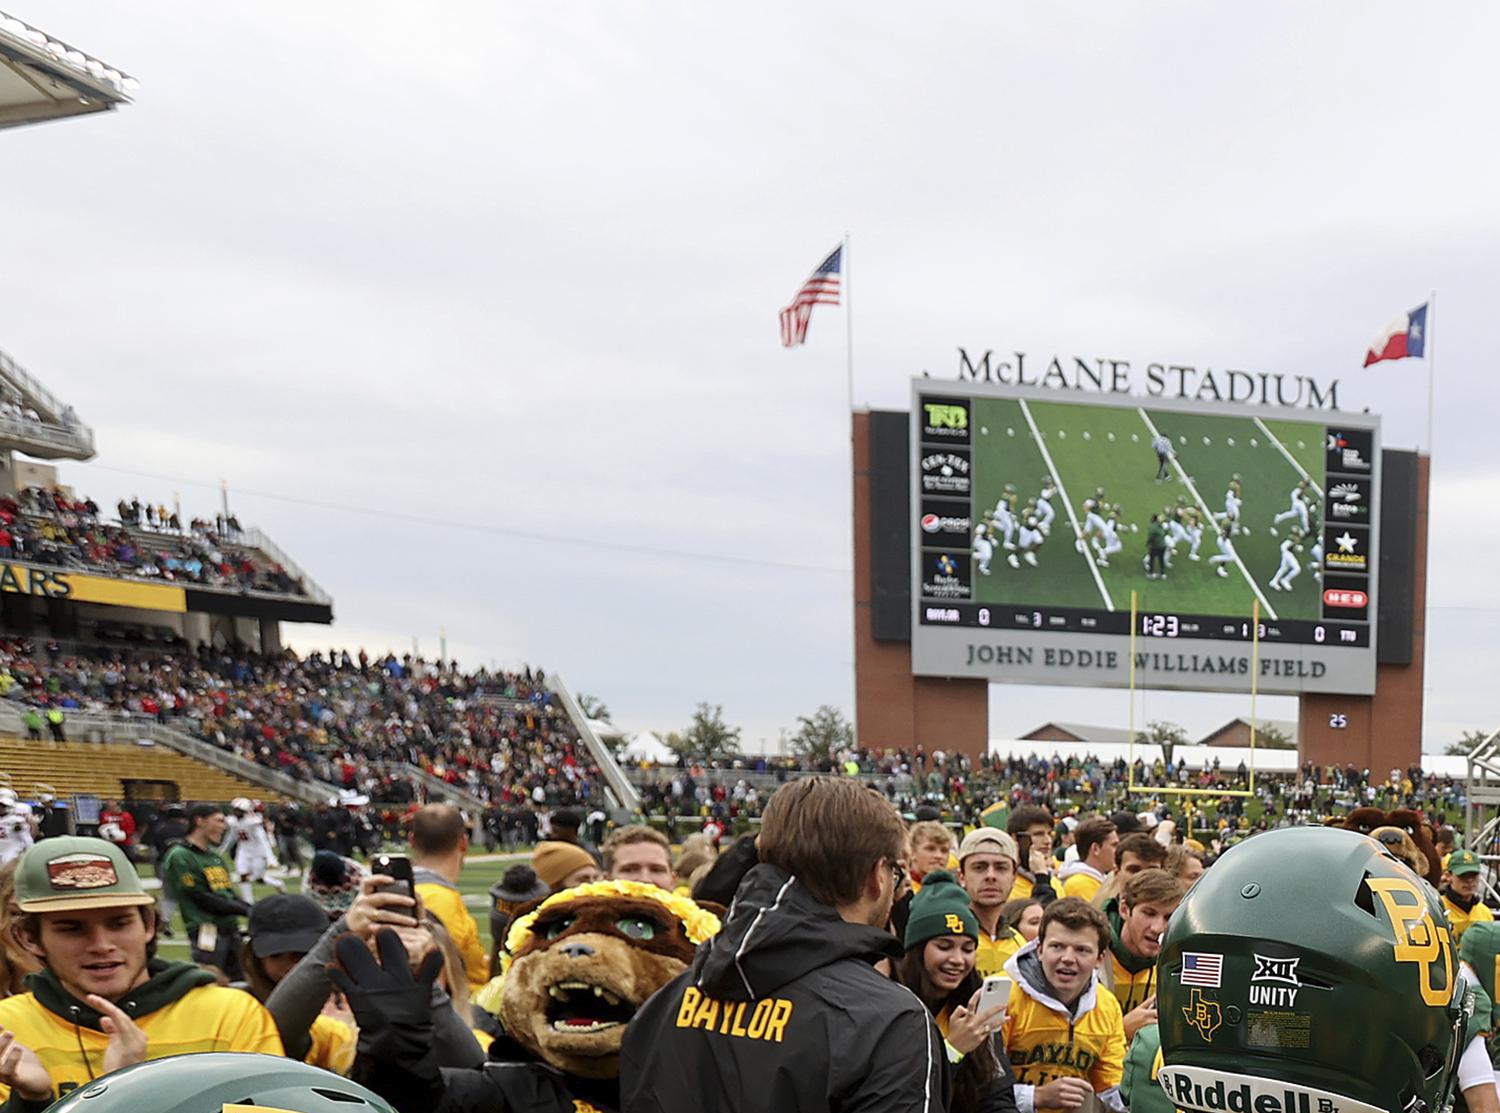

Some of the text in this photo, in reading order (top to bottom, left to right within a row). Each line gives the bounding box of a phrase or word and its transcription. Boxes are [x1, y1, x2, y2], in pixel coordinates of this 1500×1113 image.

[958, 347, 1340, 411] McLANE STADIUM
[0, 564, 72, 598] ARS
[978, 608, 990, 626] 0
[1143, 615, 1179, 637] 1:23
[1314, 626, 1325, 642] 0
[966, 644, 1326, 678] JOHN EDDIE WILLIAMS FIELD
[1329, 714, 1346, 728] 25
[1249, 985, 1298, 1008] UNITY
[676, 986, 793, 1043] BAYLOR
